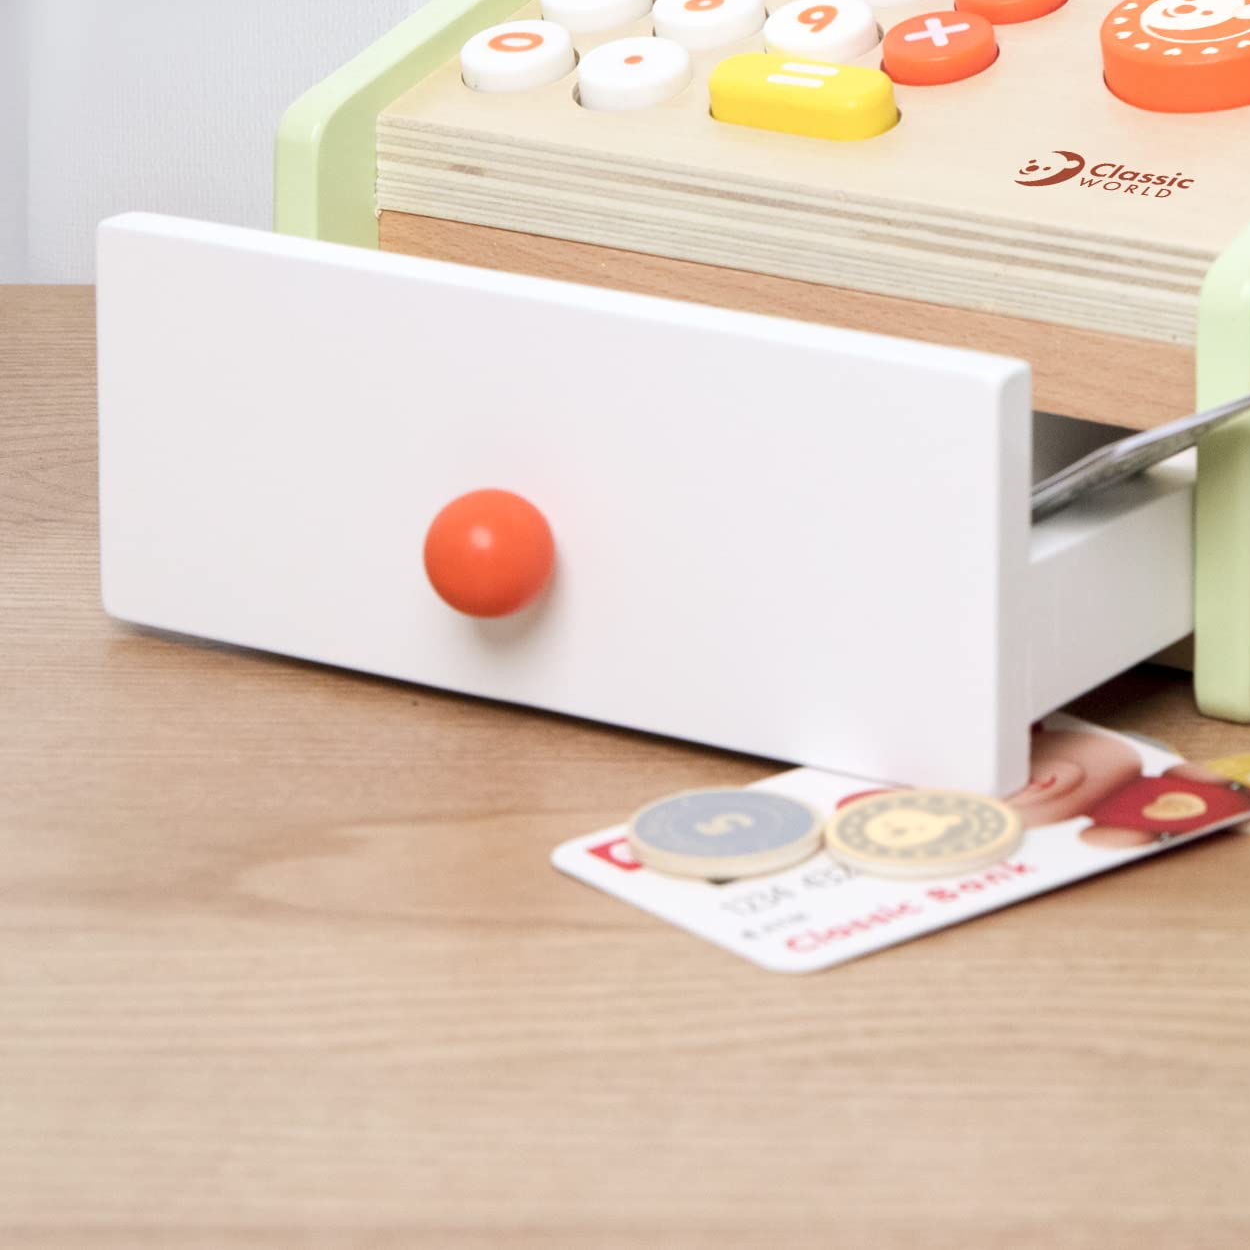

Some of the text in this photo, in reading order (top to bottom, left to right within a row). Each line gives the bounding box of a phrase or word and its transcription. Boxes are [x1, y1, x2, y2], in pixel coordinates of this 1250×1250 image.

[797, 5, 839, 33] 9
[487, 31, 545, 54] 0
[1079, 177, 1173, 199] WORLD
[1090, 162, 1195, 190] Classic
